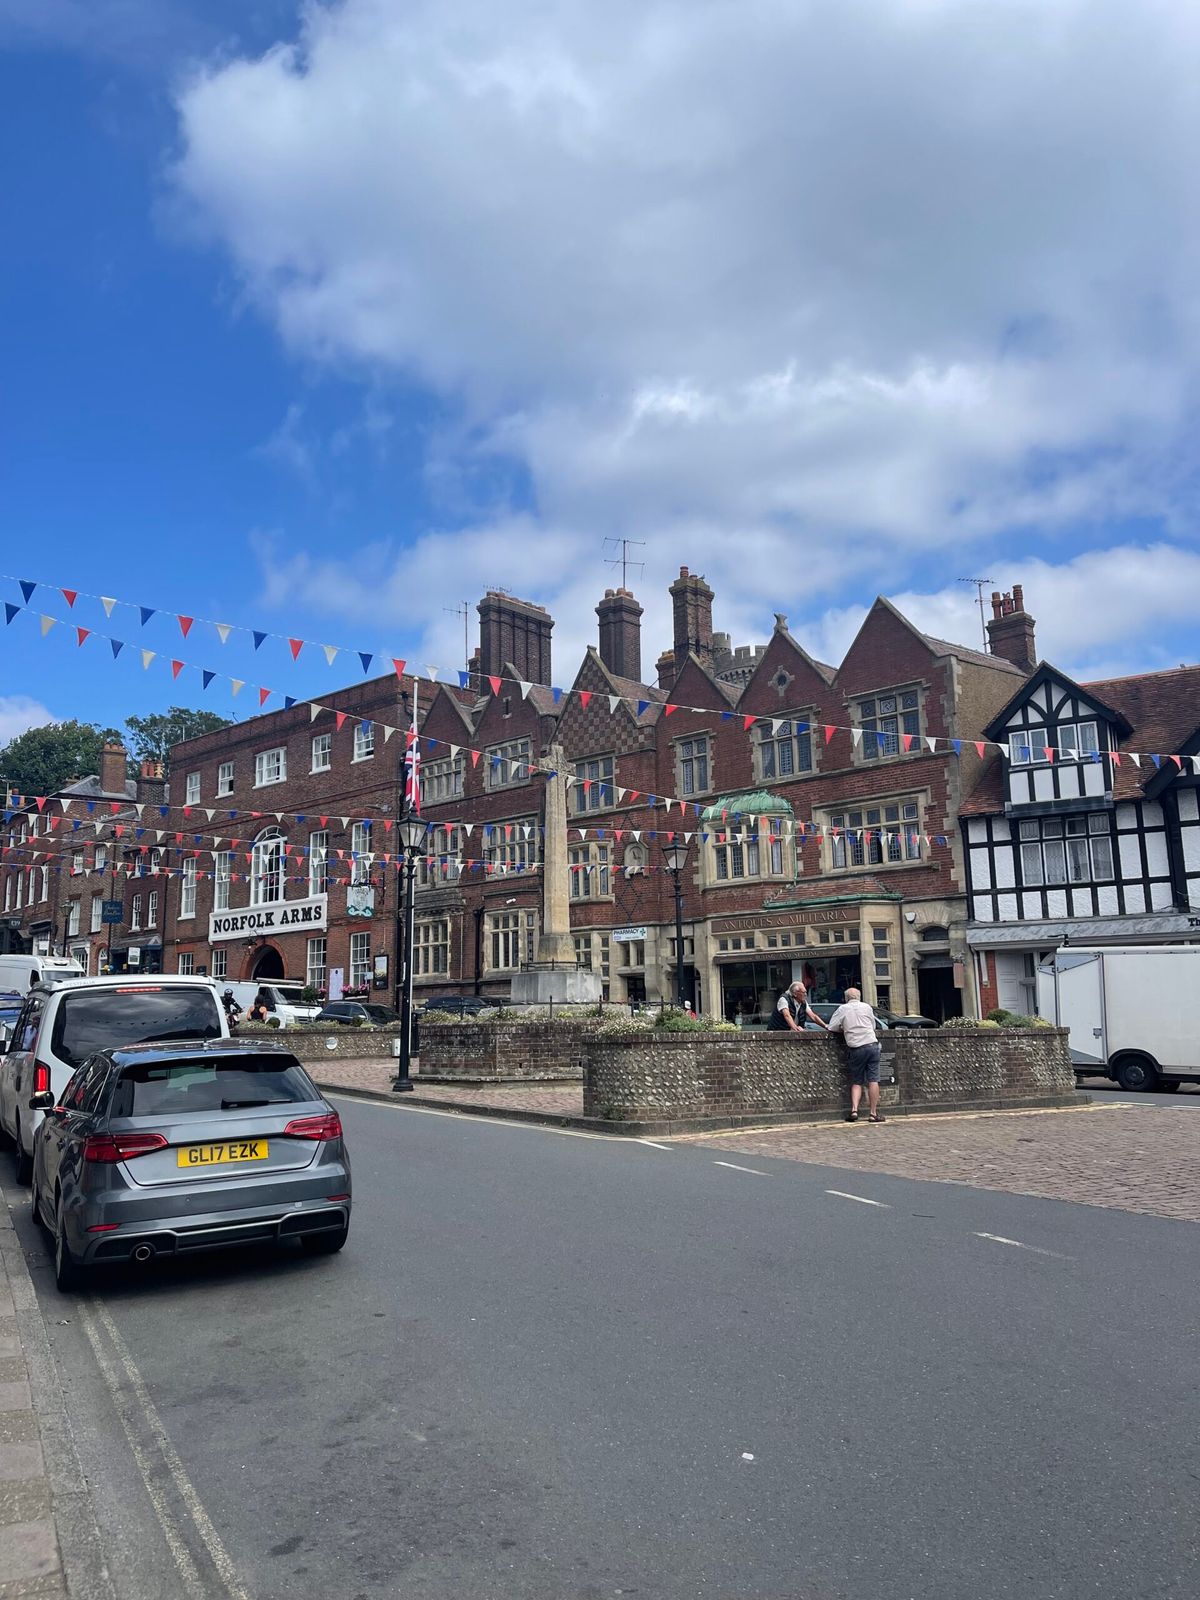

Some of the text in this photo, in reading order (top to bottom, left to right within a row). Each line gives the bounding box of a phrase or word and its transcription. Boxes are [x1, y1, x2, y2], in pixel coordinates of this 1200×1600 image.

[213, 905, 322, 934] NORFOLK ARMS
[720, 909, 848, 931] ANTIQUES & MILITARIA
[613, 928, 640, 936] PHARMACY
[188, 1142, 259, 1164] GL17 EZK
